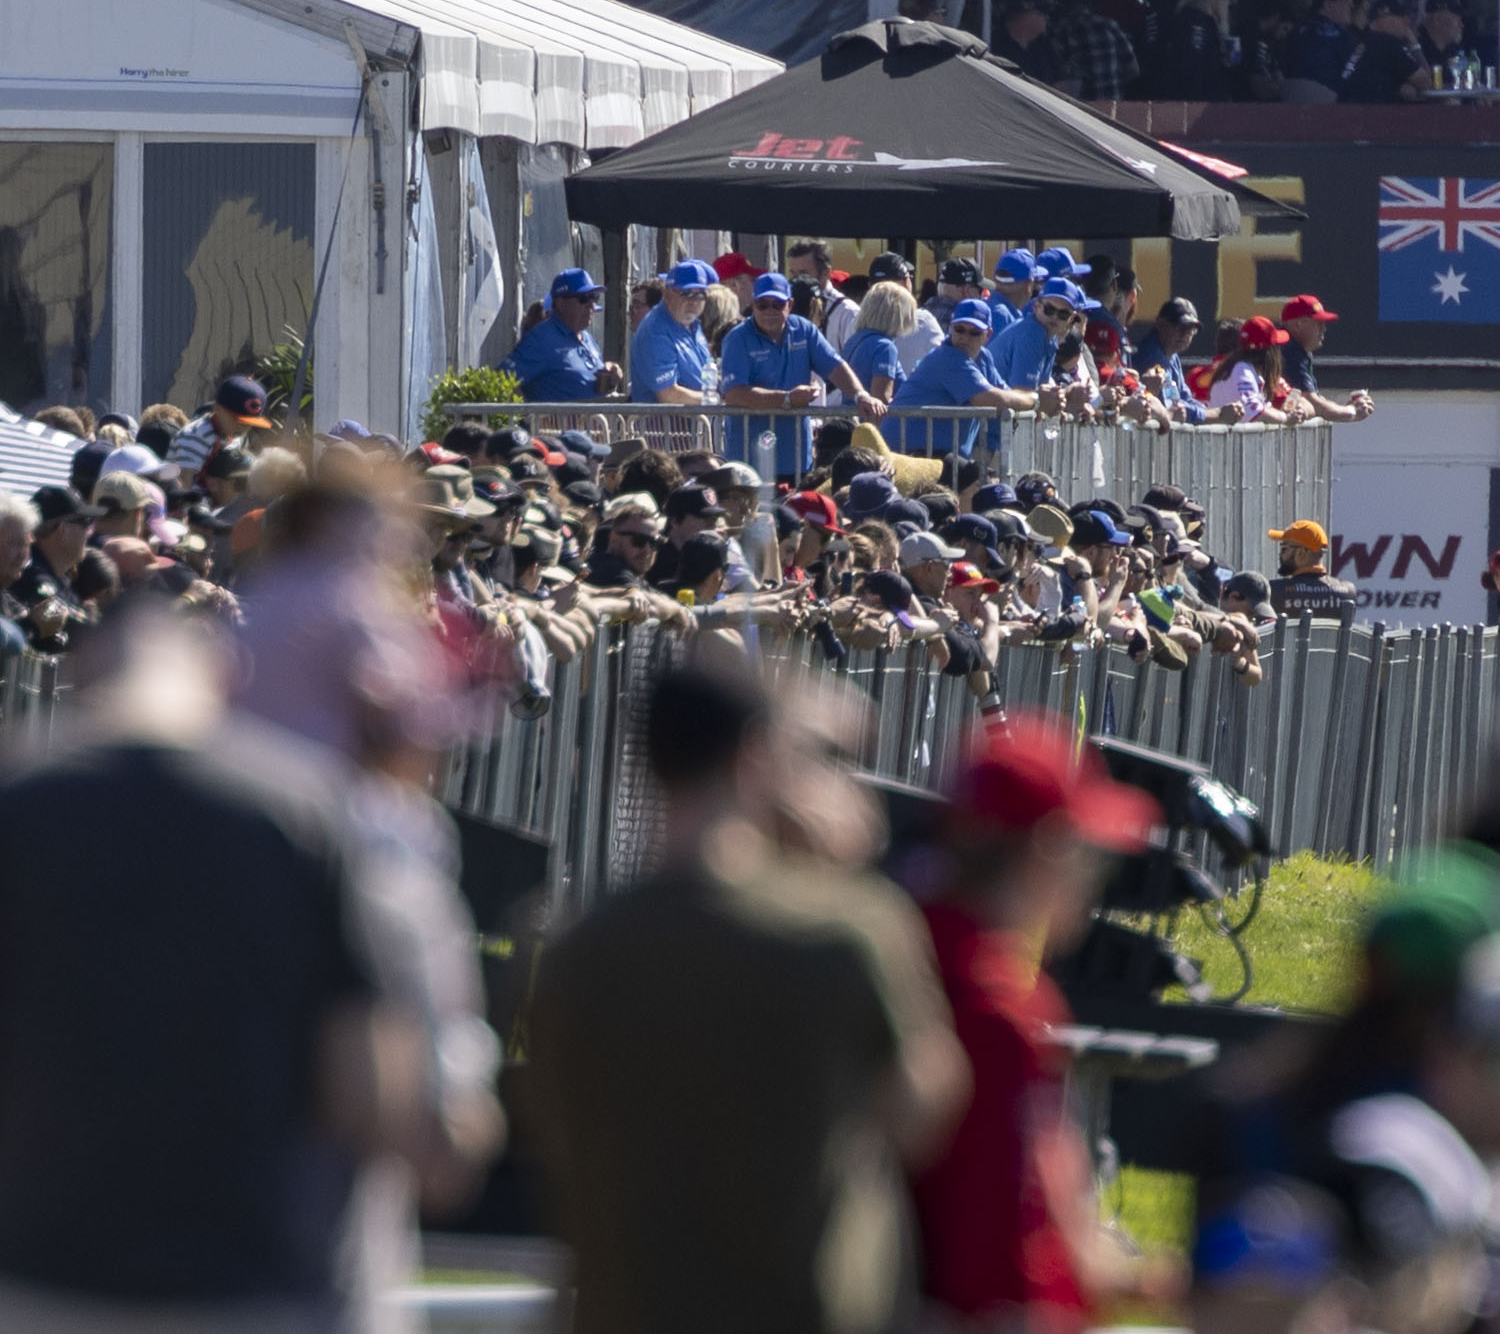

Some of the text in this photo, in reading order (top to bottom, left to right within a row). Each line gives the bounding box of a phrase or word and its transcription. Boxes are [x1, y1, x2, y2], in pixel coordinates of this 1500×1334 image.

[731, 131, 864, 159] Jet
[727, 160, 855, 174] COURIERS
[1284, 595, 1341, 609] securit
